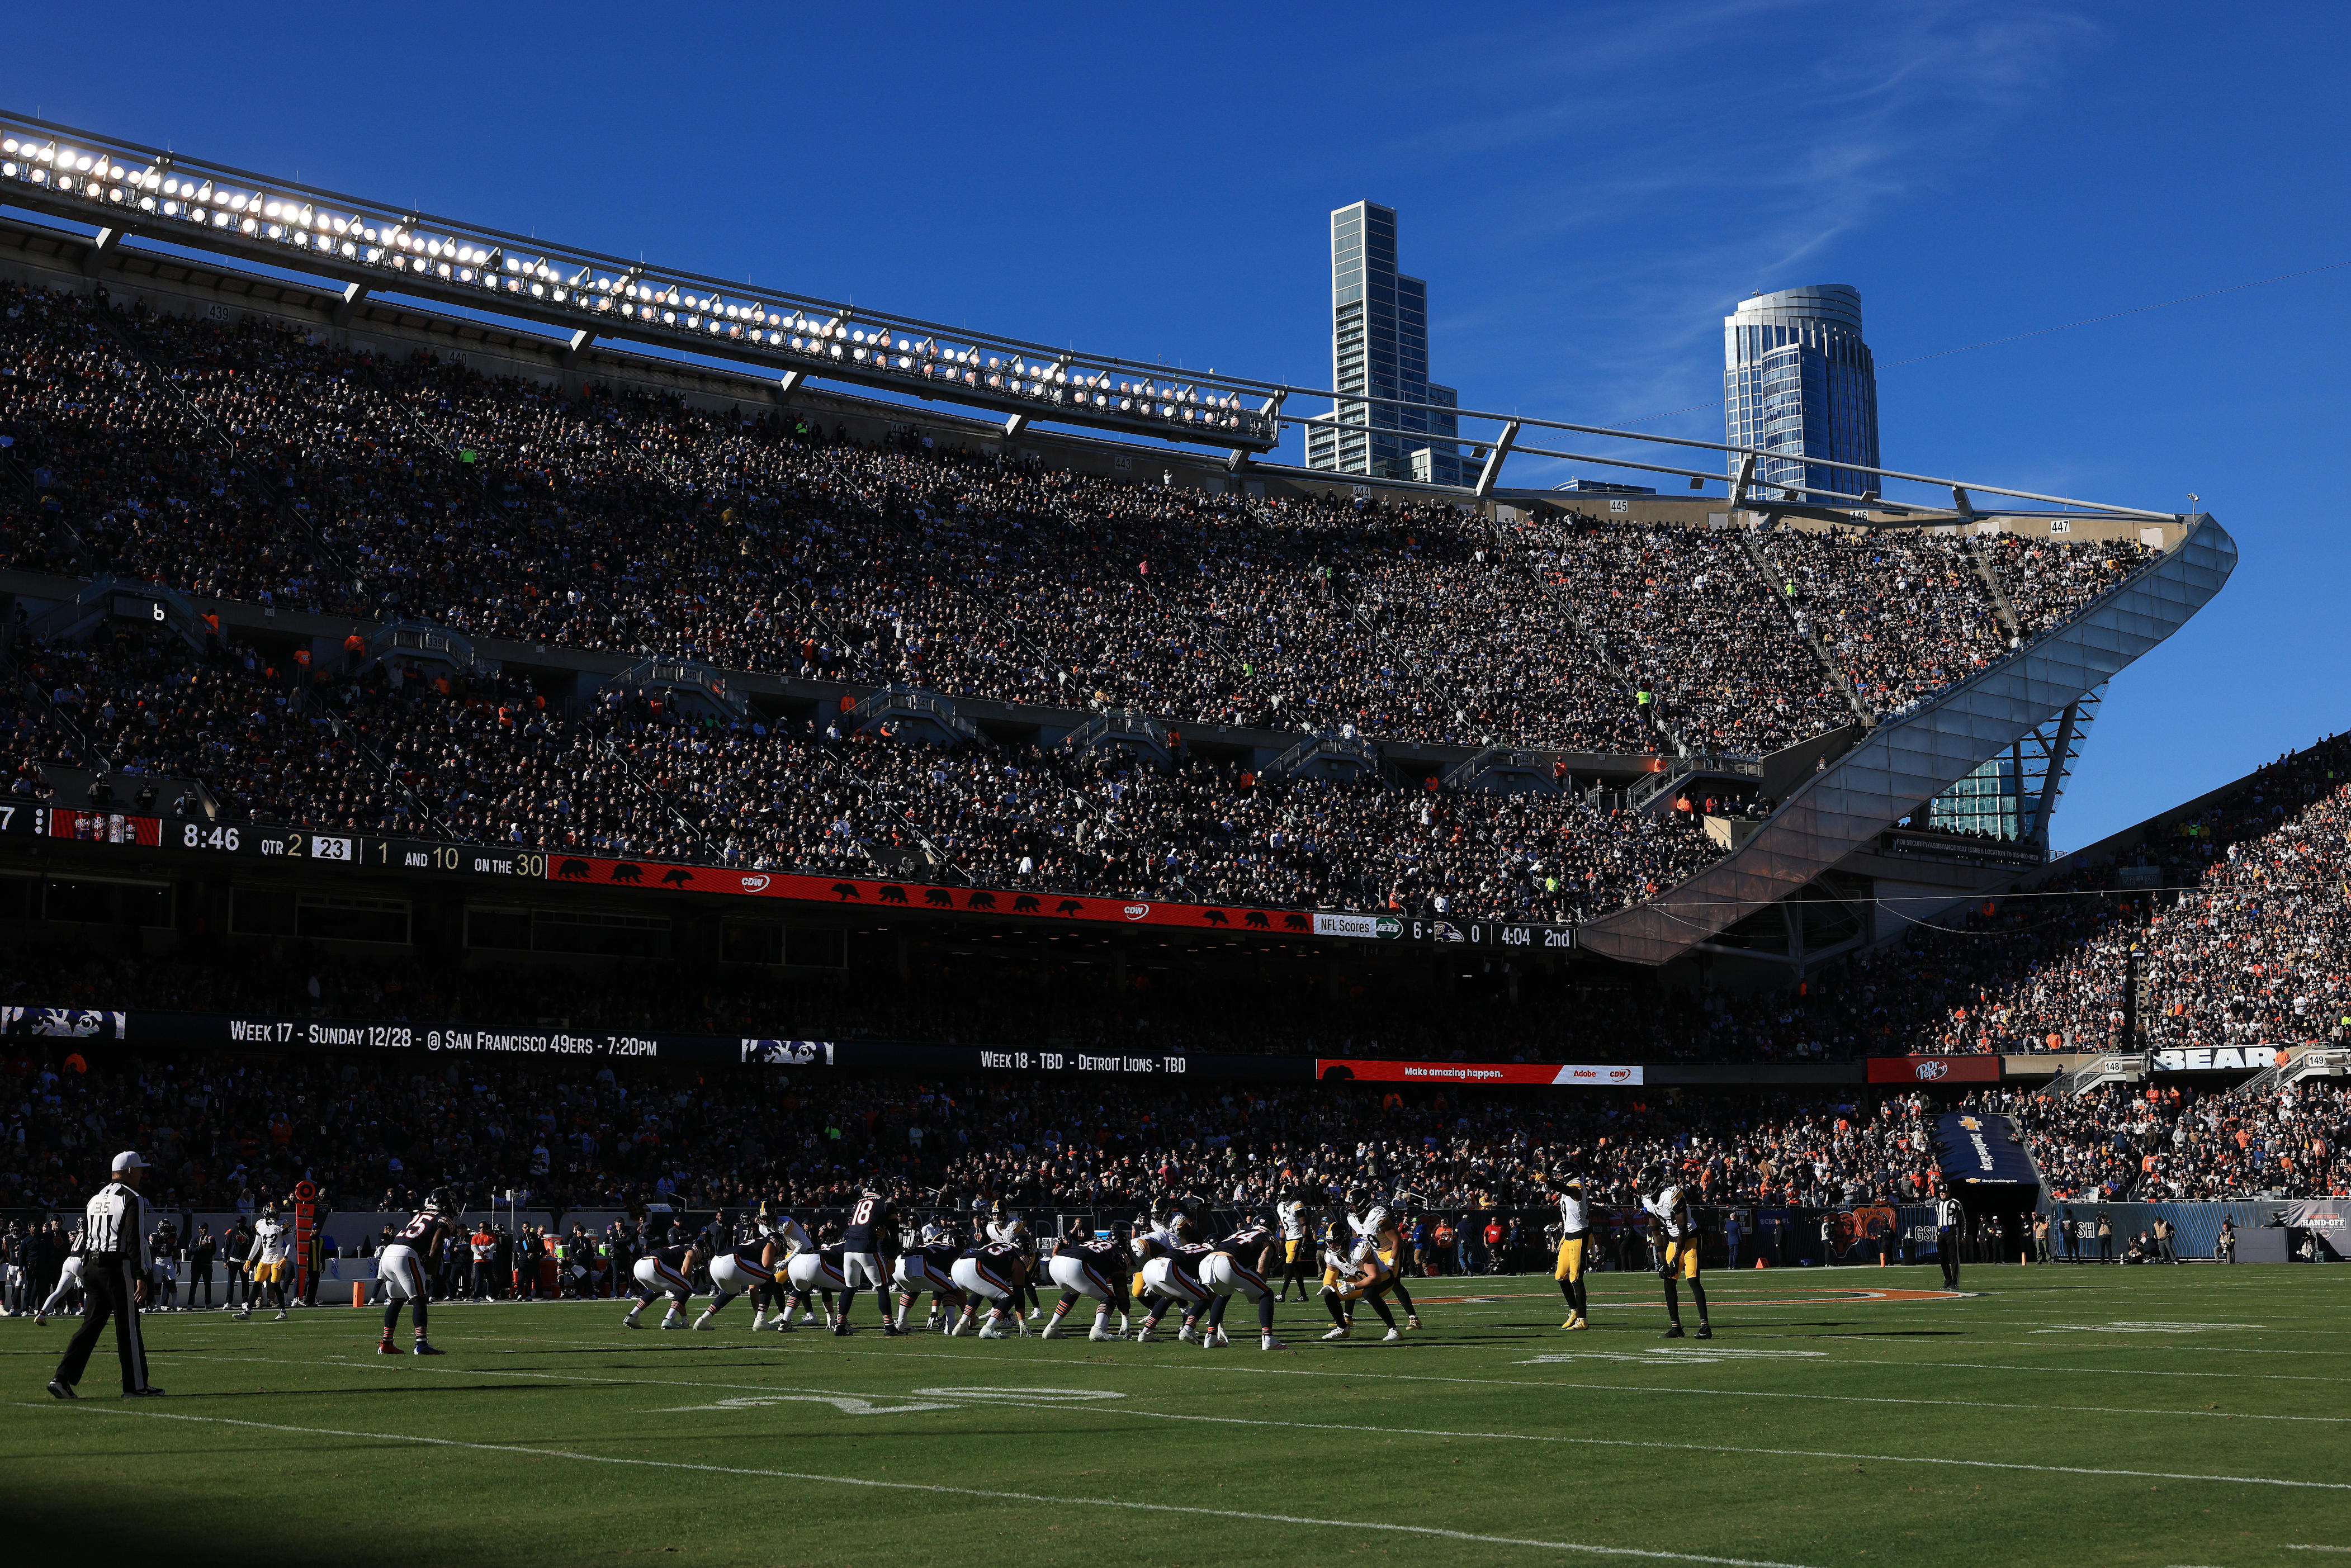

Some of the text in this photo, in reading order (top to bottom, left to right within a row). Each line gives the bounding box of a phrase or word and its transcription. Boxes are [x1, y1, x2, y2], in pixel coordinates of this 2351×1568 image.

[210, 306, 229, 321] 439
[1116, 458, 1130, 470] 443
[1611, 500, 1628, 511] 445
[1851, 511, 1867, 522] 446
[2052, 521, 2068, 532] 447
[428, 636, 442, 647] 339
[683, 670, 696, 680] 340
[917, 699, 929, 708] 341
[1132, 722, 1143, 731] 342
[1341, 742, 1352, 751] 343
[1517, 755, 1529, 764] 344
[0, 806, 15, 830] 7
[183, 823, 239, 851] 8:46
[261, 834, 301, 856] QTR 2
[319, 839, 344, 859] 23
[1906, 840, 1956, 850] SECURITY/ASSISTANCE
[1985, 849, 2006, 857] LOCATION
[379, 841, 543, 877] 1 AND 10 ON THE 30
[1321, 918, 1370, 933] NFL Scores
[1376, 923, 1400, 932] JETS
[1413, 921, 1422, 939] 6
[1472, 925, 1479, 942] 0
[1502, 927, 1570, 947] 4:04 2nd
[277, 1023, 293, 1043] 17
[368, 1027, 411, 1046] 12/28
[427, 1031, 441, 1050] @
[1014, 1052, 1028, 1068] 18
[1039, 1053, 1063, 1069] TBD
[1163, 1057, 1186, 1073] TBD
[1927, 1060, 1940, 1071] Dr
[2309, 1055, 2324, 1065] 149
[2106, 1062, 2120, 1071] 148
[1404, 1067, 1503, 1079] Make amazing happen.
[94, 1202, 111, 1214] 35
[850, 1200, 874, 1226] 18
[395, 1214, 434, 1238] 25
